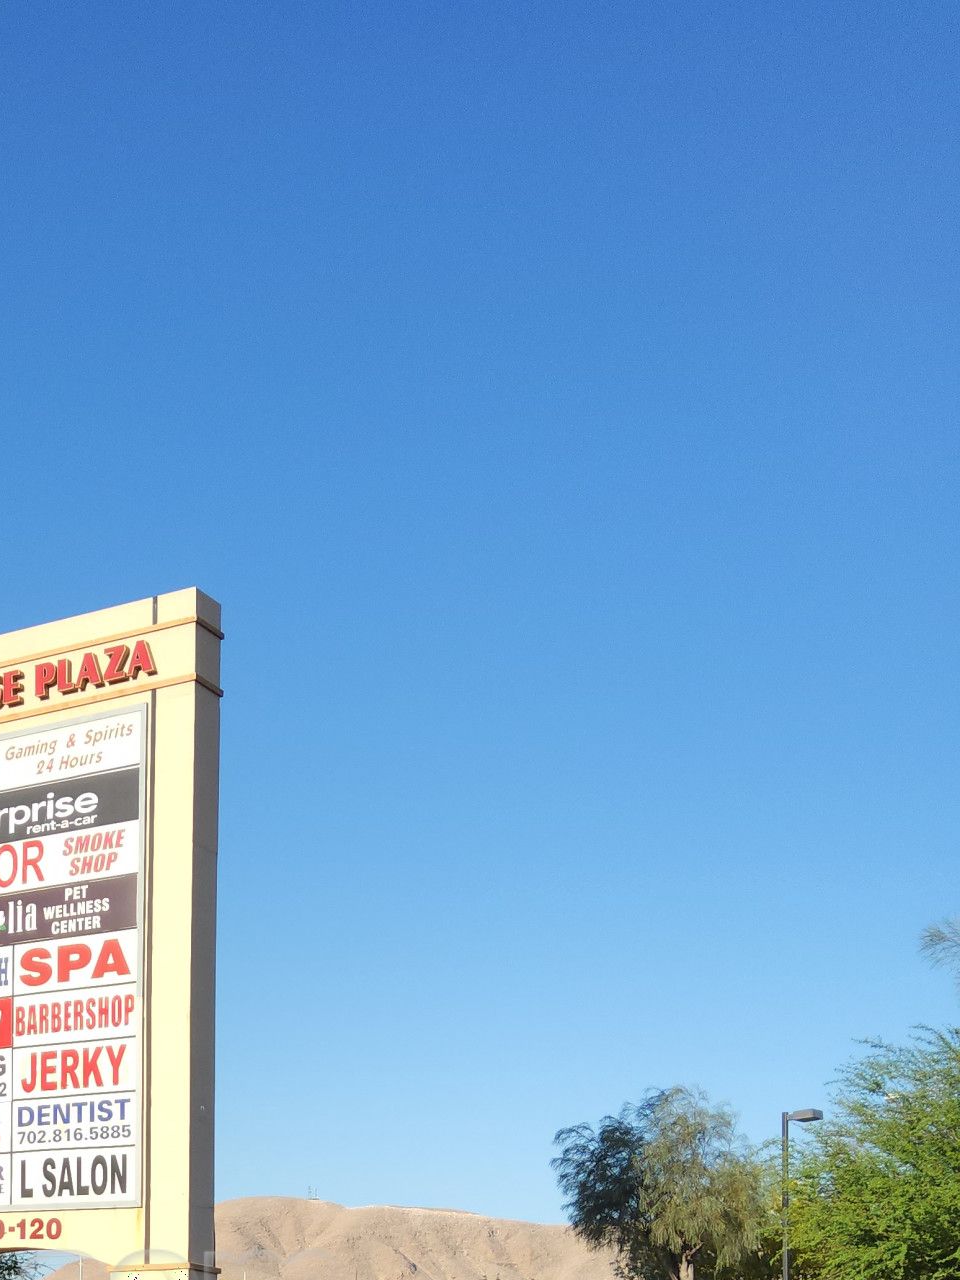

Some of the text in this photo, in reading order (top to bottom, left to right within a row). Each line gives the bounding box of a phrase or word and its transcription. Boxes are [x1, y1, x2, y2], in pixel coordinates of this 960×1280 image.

[35, 640, 157, 700] PLAZA
[5, 722, 133, 761] Gaming & Spirits
[37, 749, 102, 775] 24 Hours
[26, 812, 98, 835] rent-a-car
[62, 829, 125, 857] SMOKE
[69, 852, 118, 876] SHOP
[64, 884, 89, 901] PET
[43, 898, 110, 921] WELLNESS
[51, 915, 102, 935] CENTER
[19, 938, 131, 987] SPA
[15, 994, 135, 1038] BARBERSHOP
[21, 1044, 127, 1094] JERKY
[17, 1098, 131, 1128] DENTIST
[17, 1125, 132, 1146] 702.816.5885
[21, 1154, 127, 1199] L SALON
